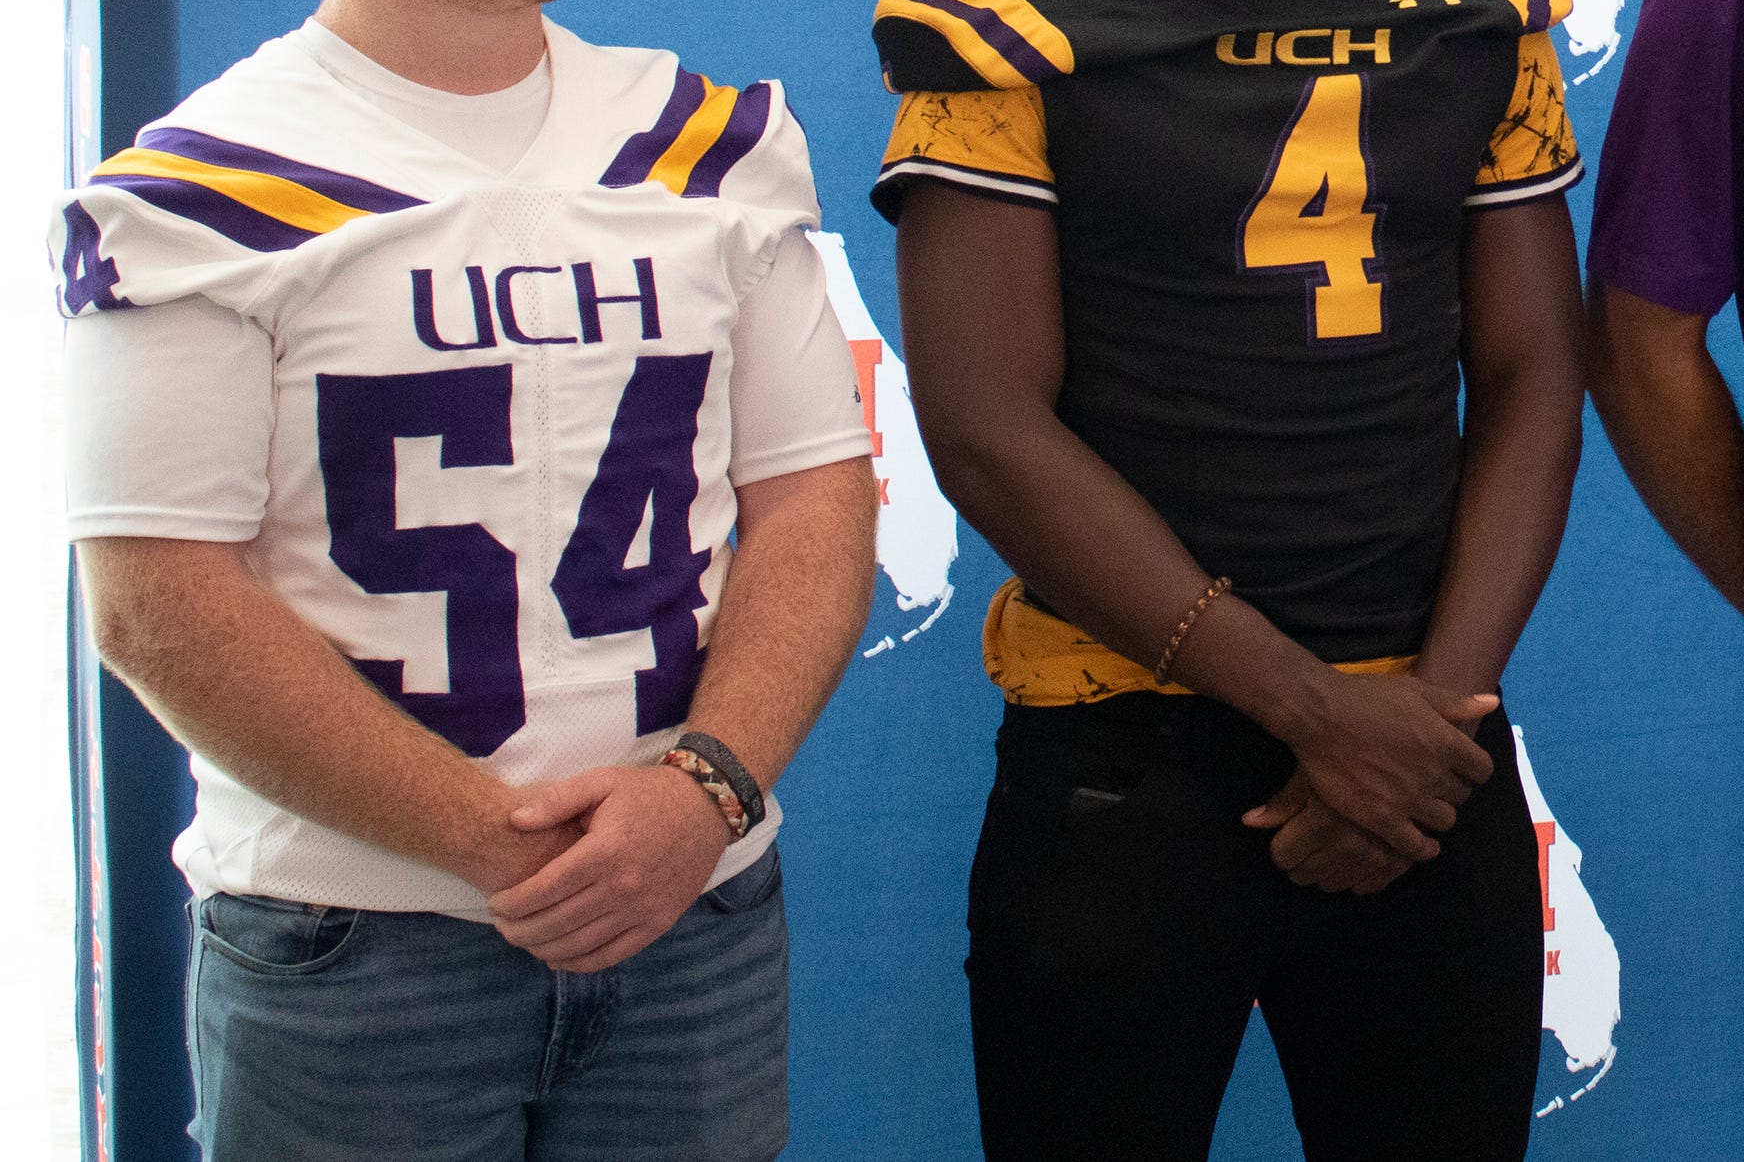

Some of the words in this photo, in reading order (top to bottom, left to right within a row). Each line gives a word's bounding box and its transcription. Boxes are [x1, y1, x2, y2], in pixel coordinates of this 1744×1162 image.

[1215, 28, 1391, 66] UCH
[46, 198, 136, 318] 4
[1237, 71, 1386, 345] 4
[411, 256, 664, 351] UCH
[316, 351, 713, 758] 54
